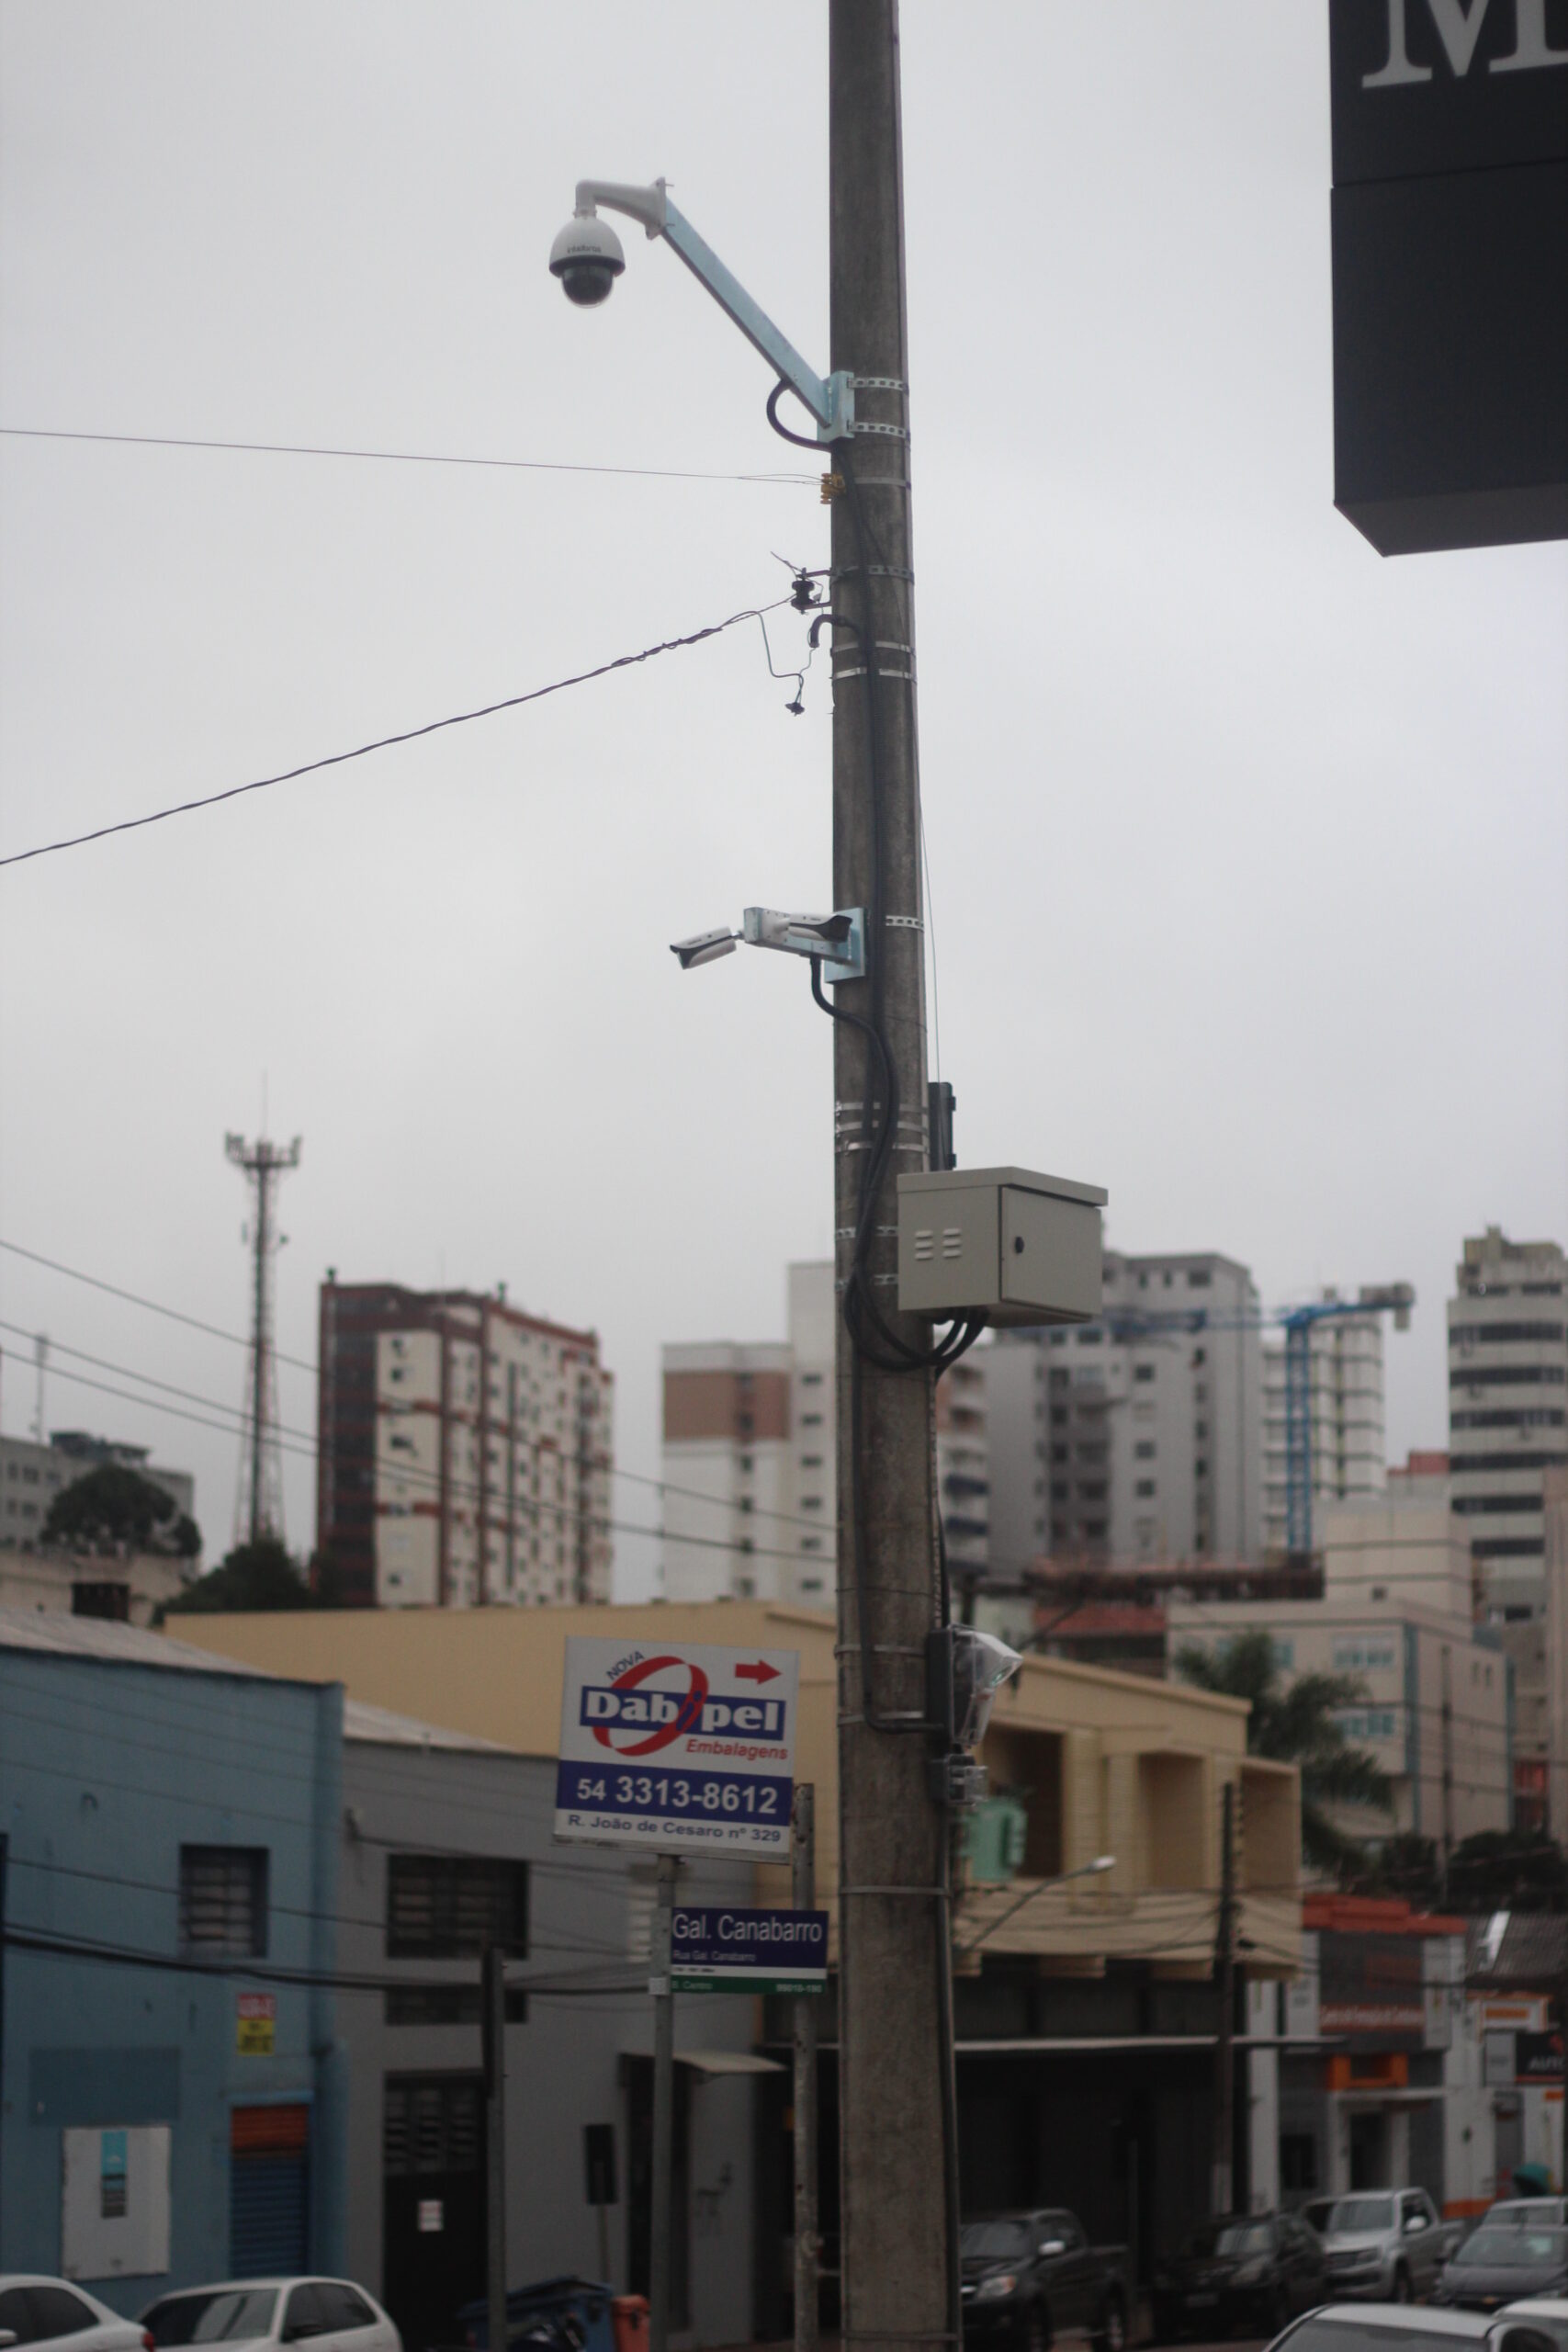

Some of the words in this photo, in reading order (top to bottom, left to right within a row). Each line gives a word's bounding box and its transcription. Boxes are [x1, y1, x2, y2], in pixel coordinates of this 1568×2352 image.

[606, 1651, 645, 1680] NOVA
[685, 1739, 789, 1760] Embalagens
[577, 1778, 606, 1801] 54
[615, 1776, 778, 1815] 3313-8612
[568, 1815, 585, 1826] R.
[591, 1816, 632, 1830] João
[637, 1820, 658, 1833] de
[663, 1822, 724, 1838] Cesaro
[751, 1828, 781, 1842] 329
[672, 1914, 712, 1939] Gal.
[717, 1915, 823, 1942] Canabarro
